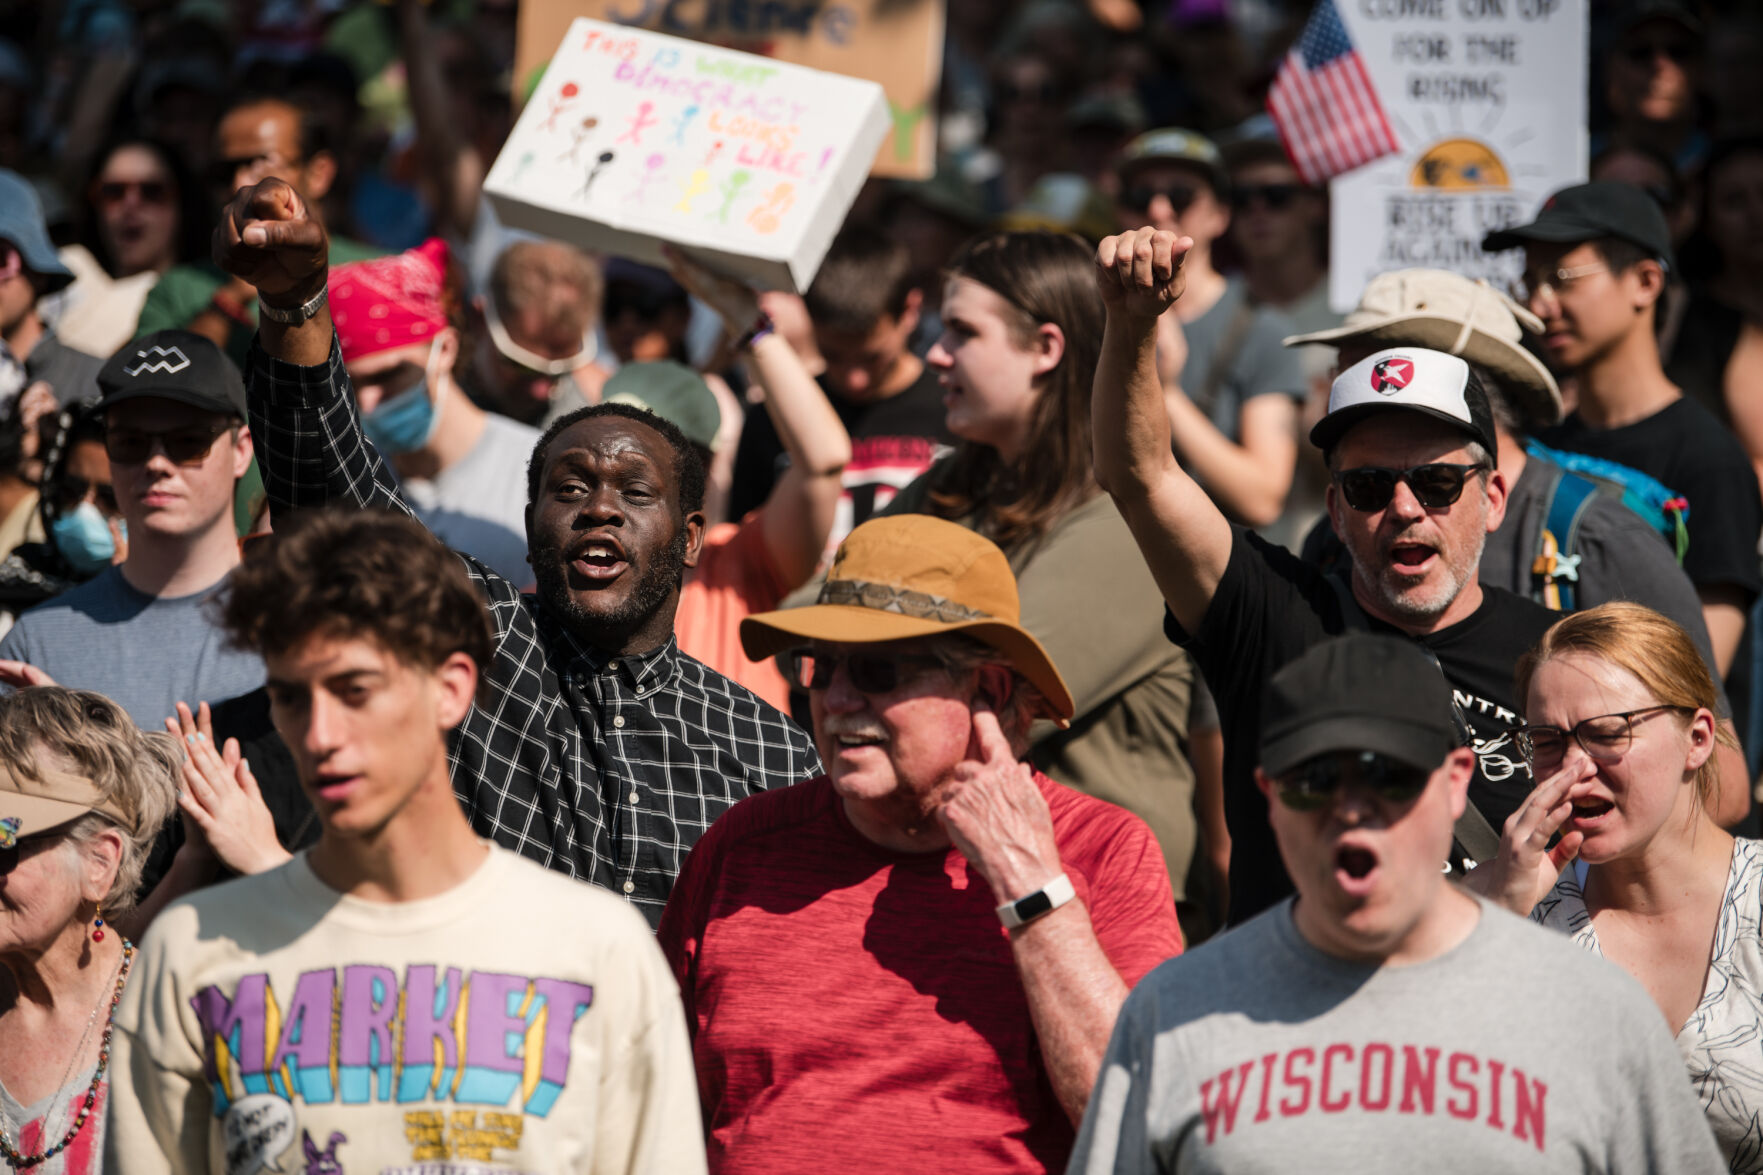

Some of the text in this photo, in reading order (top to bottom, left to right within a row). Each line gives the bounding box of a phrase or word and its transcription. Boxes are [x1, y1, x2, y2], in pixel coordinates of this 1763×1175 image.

[1358, 0, 1447, 21] COME
[1459, 0, 1507, 22] ON
[582, 31, 639, 60] THIS
[1392, 33, 1521, 65] FOR THE
[1407, 72, 1506, 106] RISING
[1387, 196, 1454, 233] RISE
[189, 964, 594, 1117] MARKET
[1199, 1042, 1548, 1152] WISCONSIN
